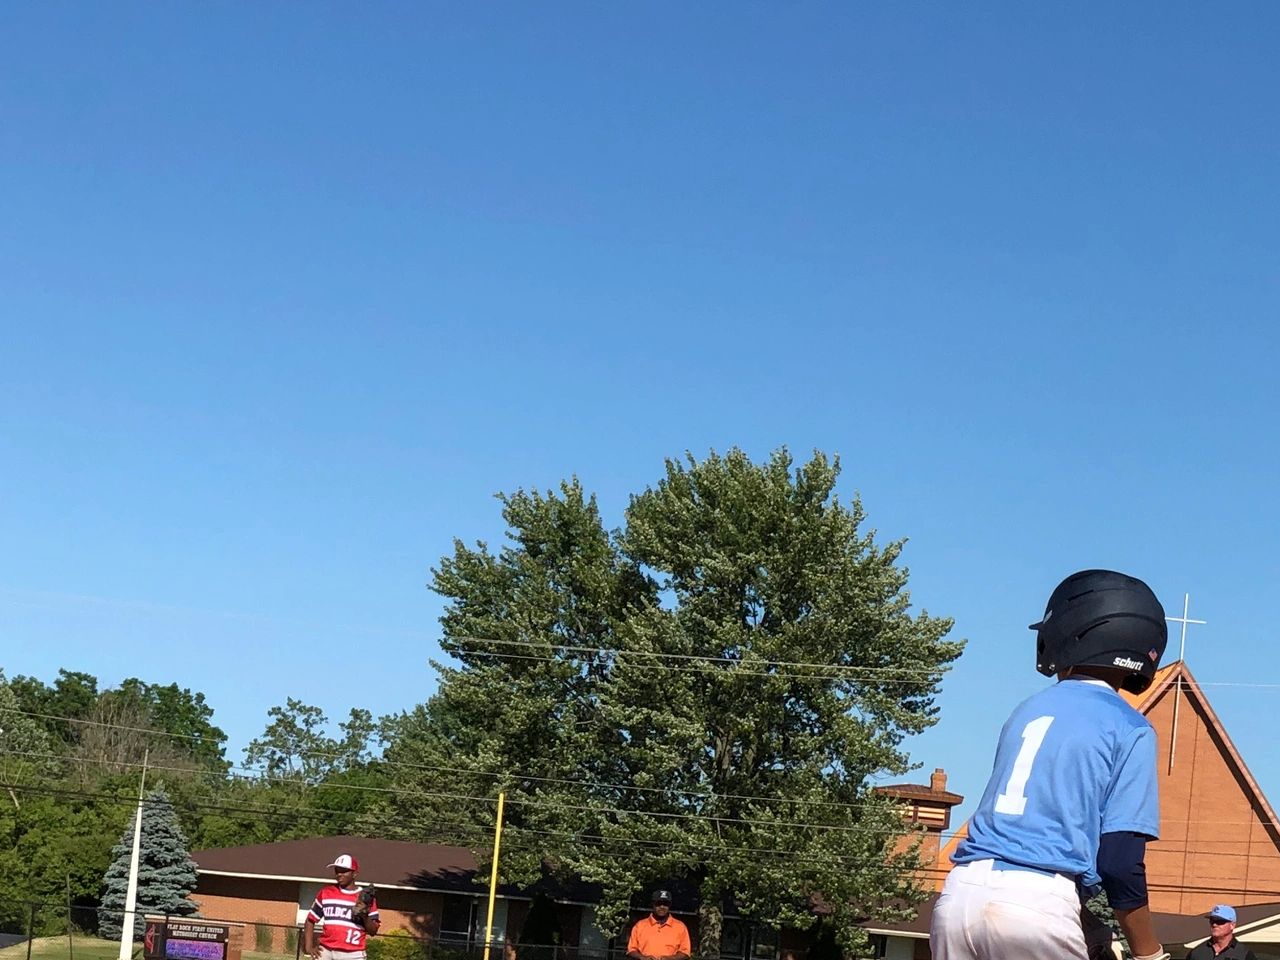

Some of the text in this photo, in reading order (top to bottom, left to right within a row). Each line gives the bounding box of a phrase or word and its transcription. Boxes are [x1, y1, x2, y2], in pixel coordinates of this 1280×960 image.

[1113, 656, 1144, 671] schutt
[994, 715, 1055, 816] 1
[322, 906, 352, 920] WILDCA
[206, 926, 224, 934] UNITED
[345, 928, 362, 945] 12
